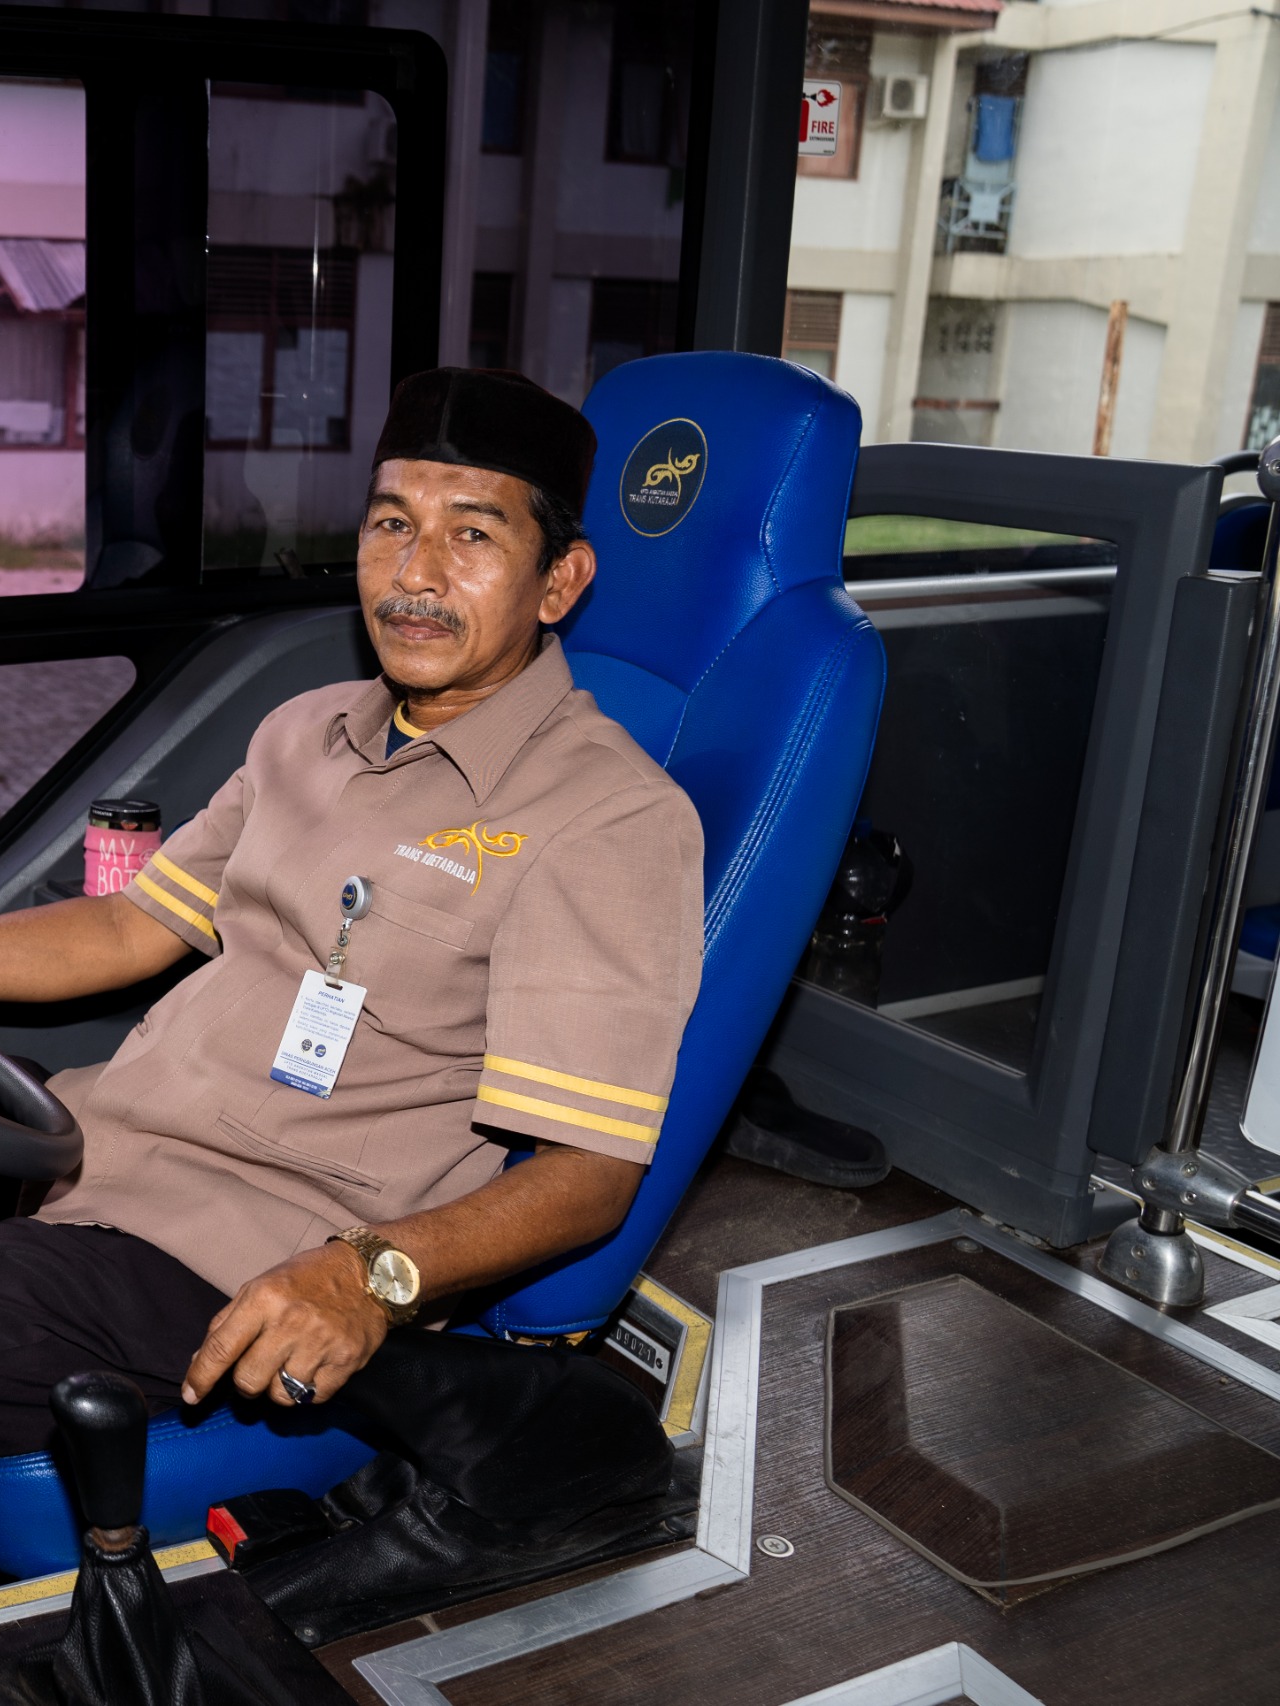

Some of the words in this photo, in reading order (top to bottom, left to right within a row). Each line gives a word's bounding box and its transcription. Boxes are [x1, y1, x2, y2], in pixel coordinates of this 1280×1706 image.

[811, 120, 835, 134] FIRE
[629, 493, 647, 504] TRANS
[100, 837, 135, 868] MY
[394, 844, 423, 862] TRANS
[420, 853, 476, 884] KOETARADJA
[97, 865, 139, 896] BOT
[318, 990, 345, 1003] PERHATIAN
[610, 1328, 651, 1361] 09021
